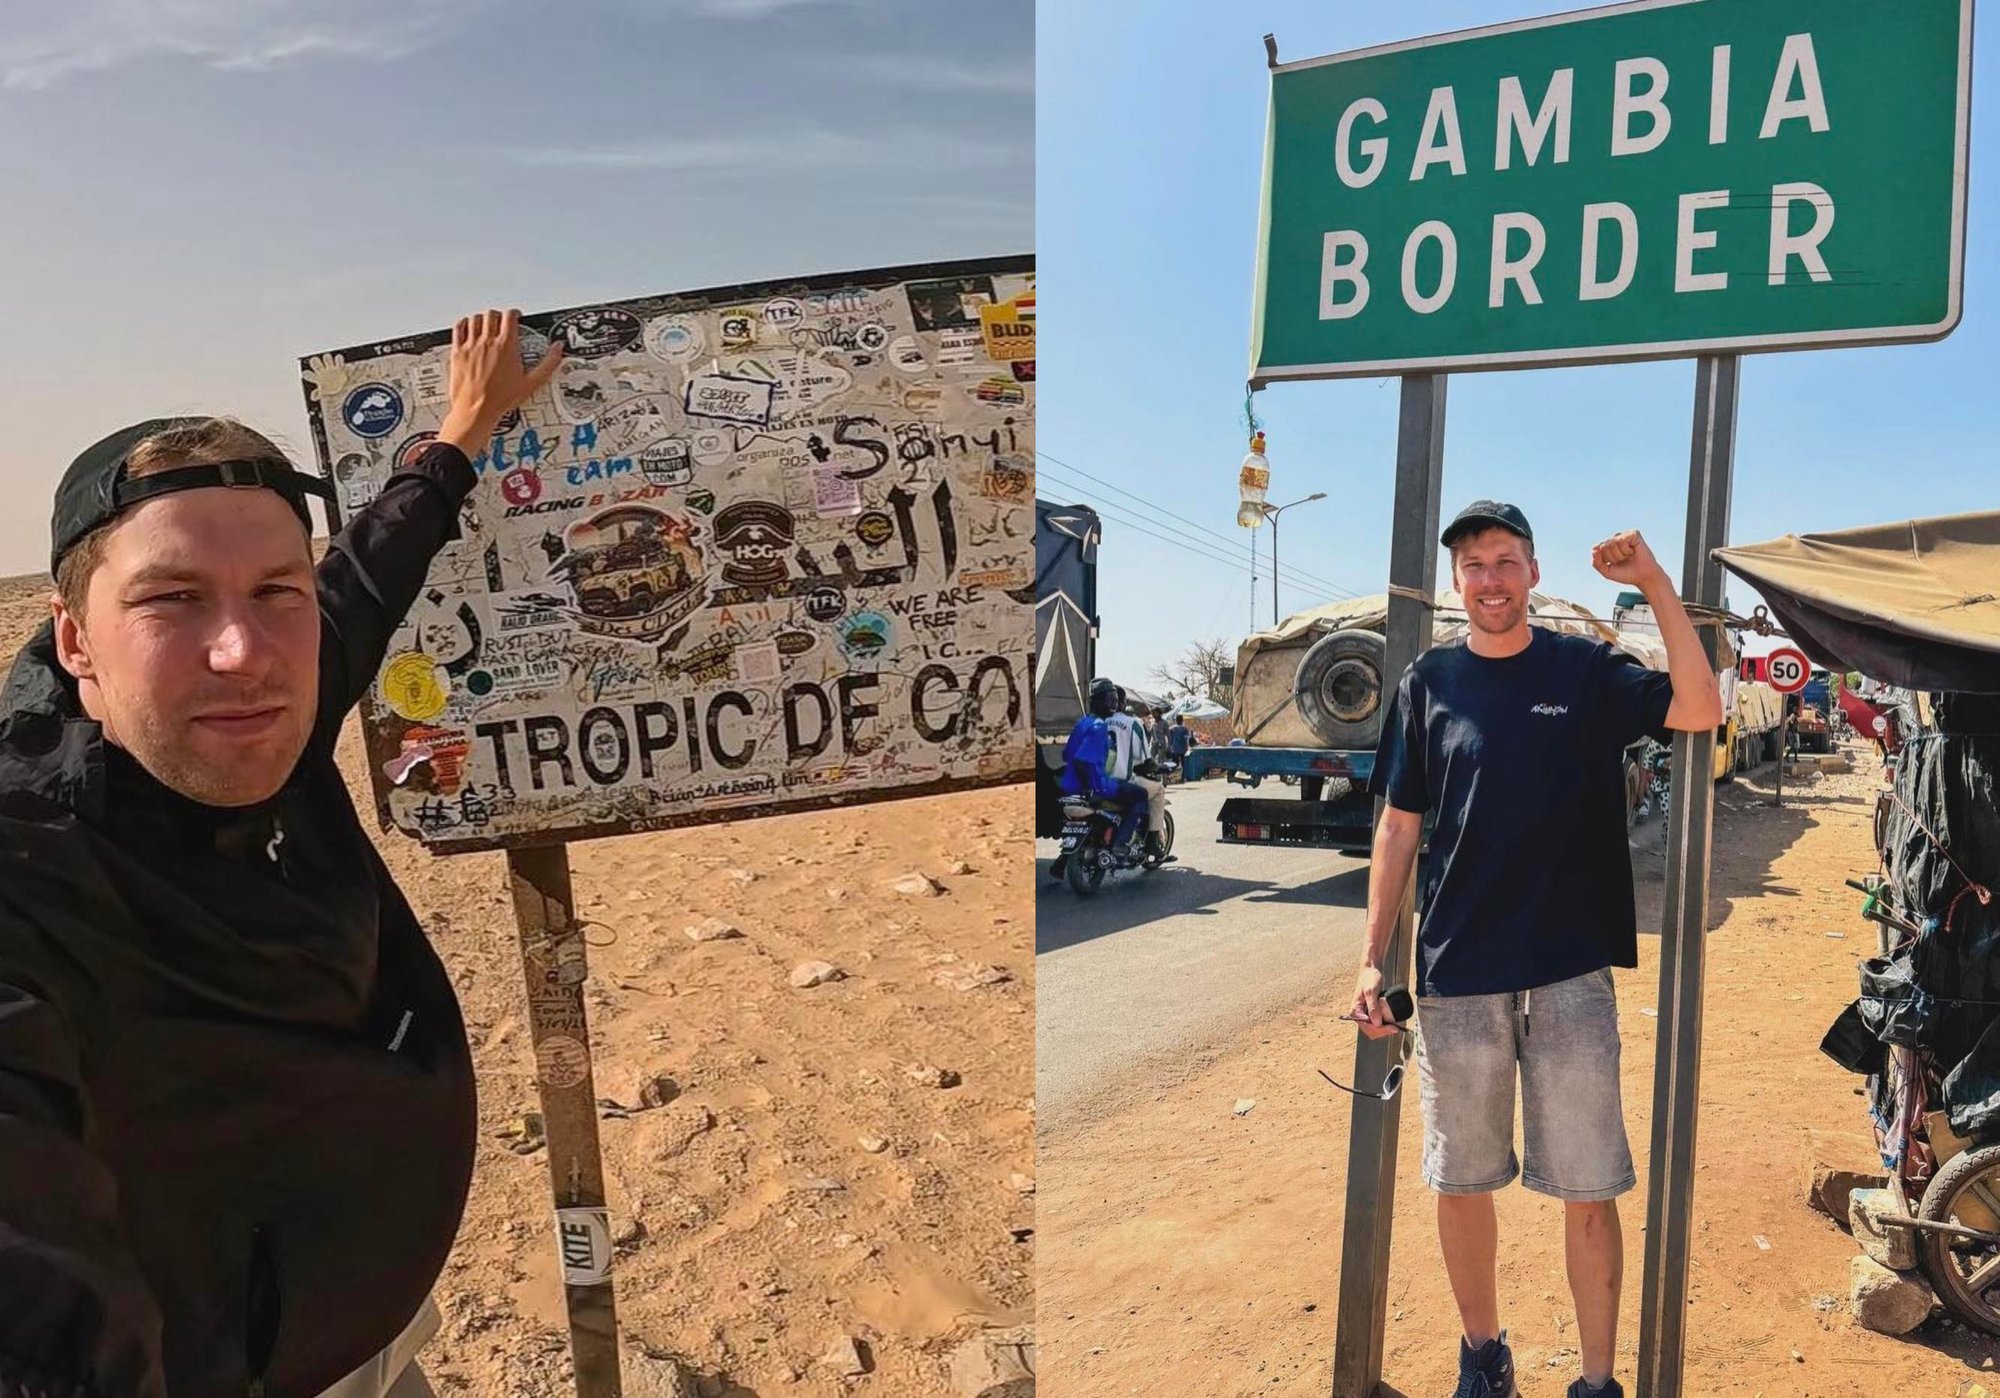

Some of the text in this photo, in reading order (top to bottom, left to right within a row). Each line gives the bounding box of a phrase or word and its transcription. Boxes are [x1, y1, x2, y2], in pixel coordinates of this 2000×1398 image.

[1335, 32, 1830, 189] GAMBIA
[1318, 182, 1836, 320] BORDER
[991, 323, 1035, 338] BUD
[504, 496, 586, 519] RACING
[736, 544, 774, 559] HOG
[888, 583, 985, 616] WE ARE
[908, 610, 958, 631] FREE
[1773, 662, 1800, 679] 50
[475, 690, 757, 790] TROPIC
[561, 1222, 592, 1270] KITE
